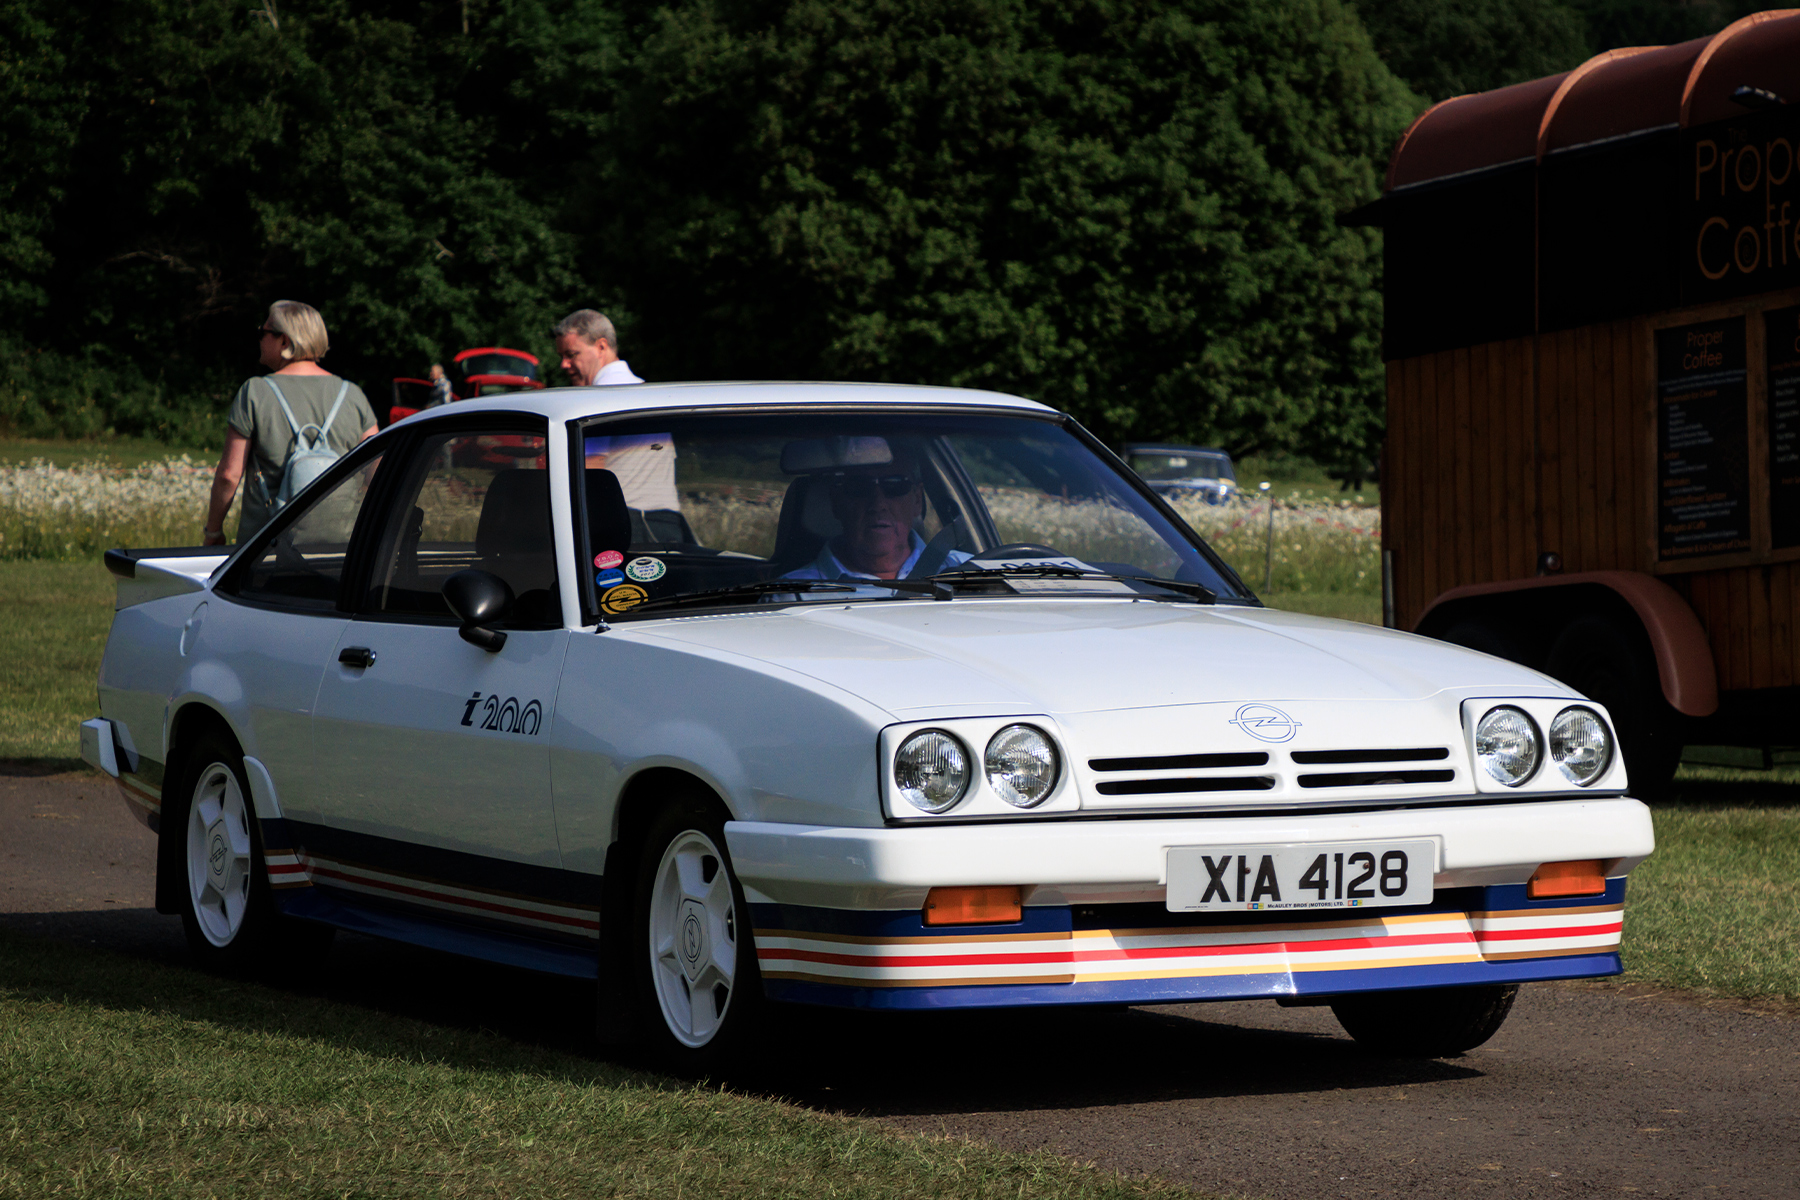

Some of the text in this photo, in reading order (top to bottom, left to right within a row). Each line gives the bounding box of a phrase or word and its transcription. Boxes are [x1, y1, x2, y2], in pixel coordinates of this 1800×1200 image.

[1695, 137, 1800, 206] Prop
[1686, 330, 1725, 348] Proper
[1683, 350, 1724, 370] Coffee
[1200, 850, 1409, 903] XIA 4128
